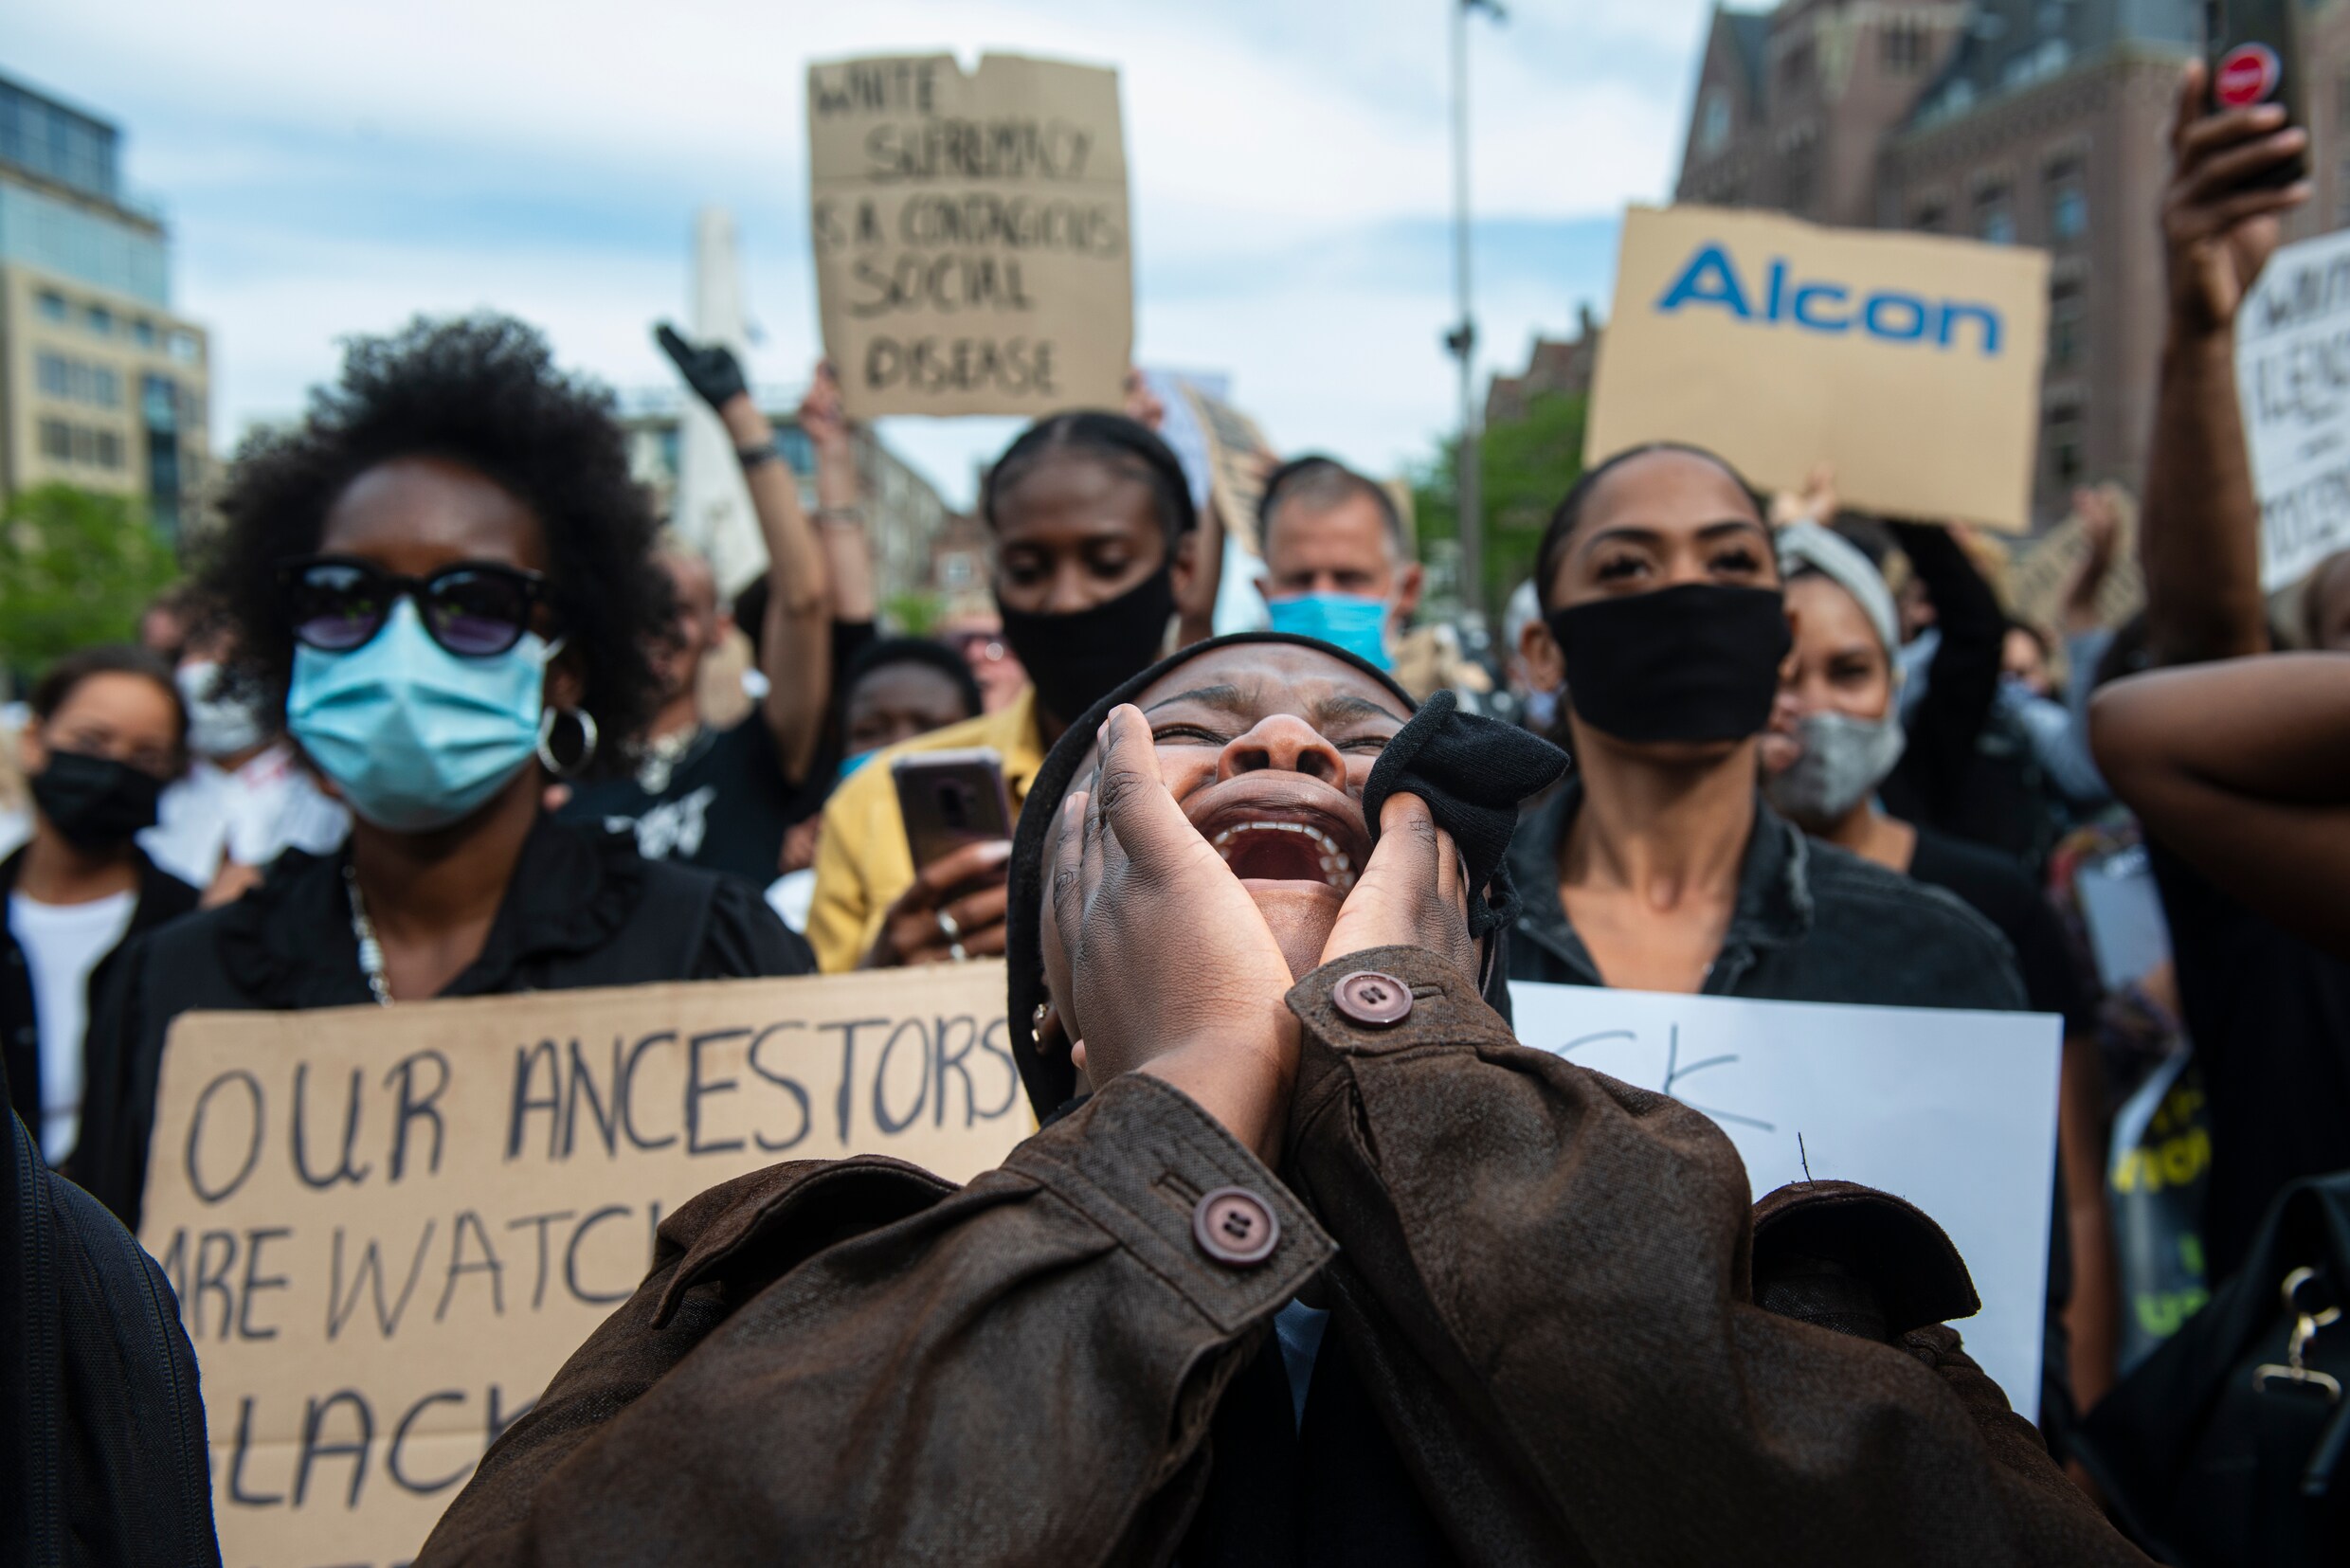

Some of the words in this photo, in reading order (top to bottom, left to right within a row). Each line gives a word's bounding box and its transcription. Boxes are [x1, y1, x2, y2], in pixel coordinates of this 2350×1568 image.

[812, 59, 936, 116] WHITE
[853, 197, 886, 248] A
[848, 250, 1035, 319] SOCIAL
[1654, 240, 2004, 357] Alcon
[863, 333, 1059, 397] DISEASE
[183, 1048, 452, 1205] OUR
[503, 1015, 1020, 1163] ANCESTORS
[159, 1226, 294, 1343] ARE
